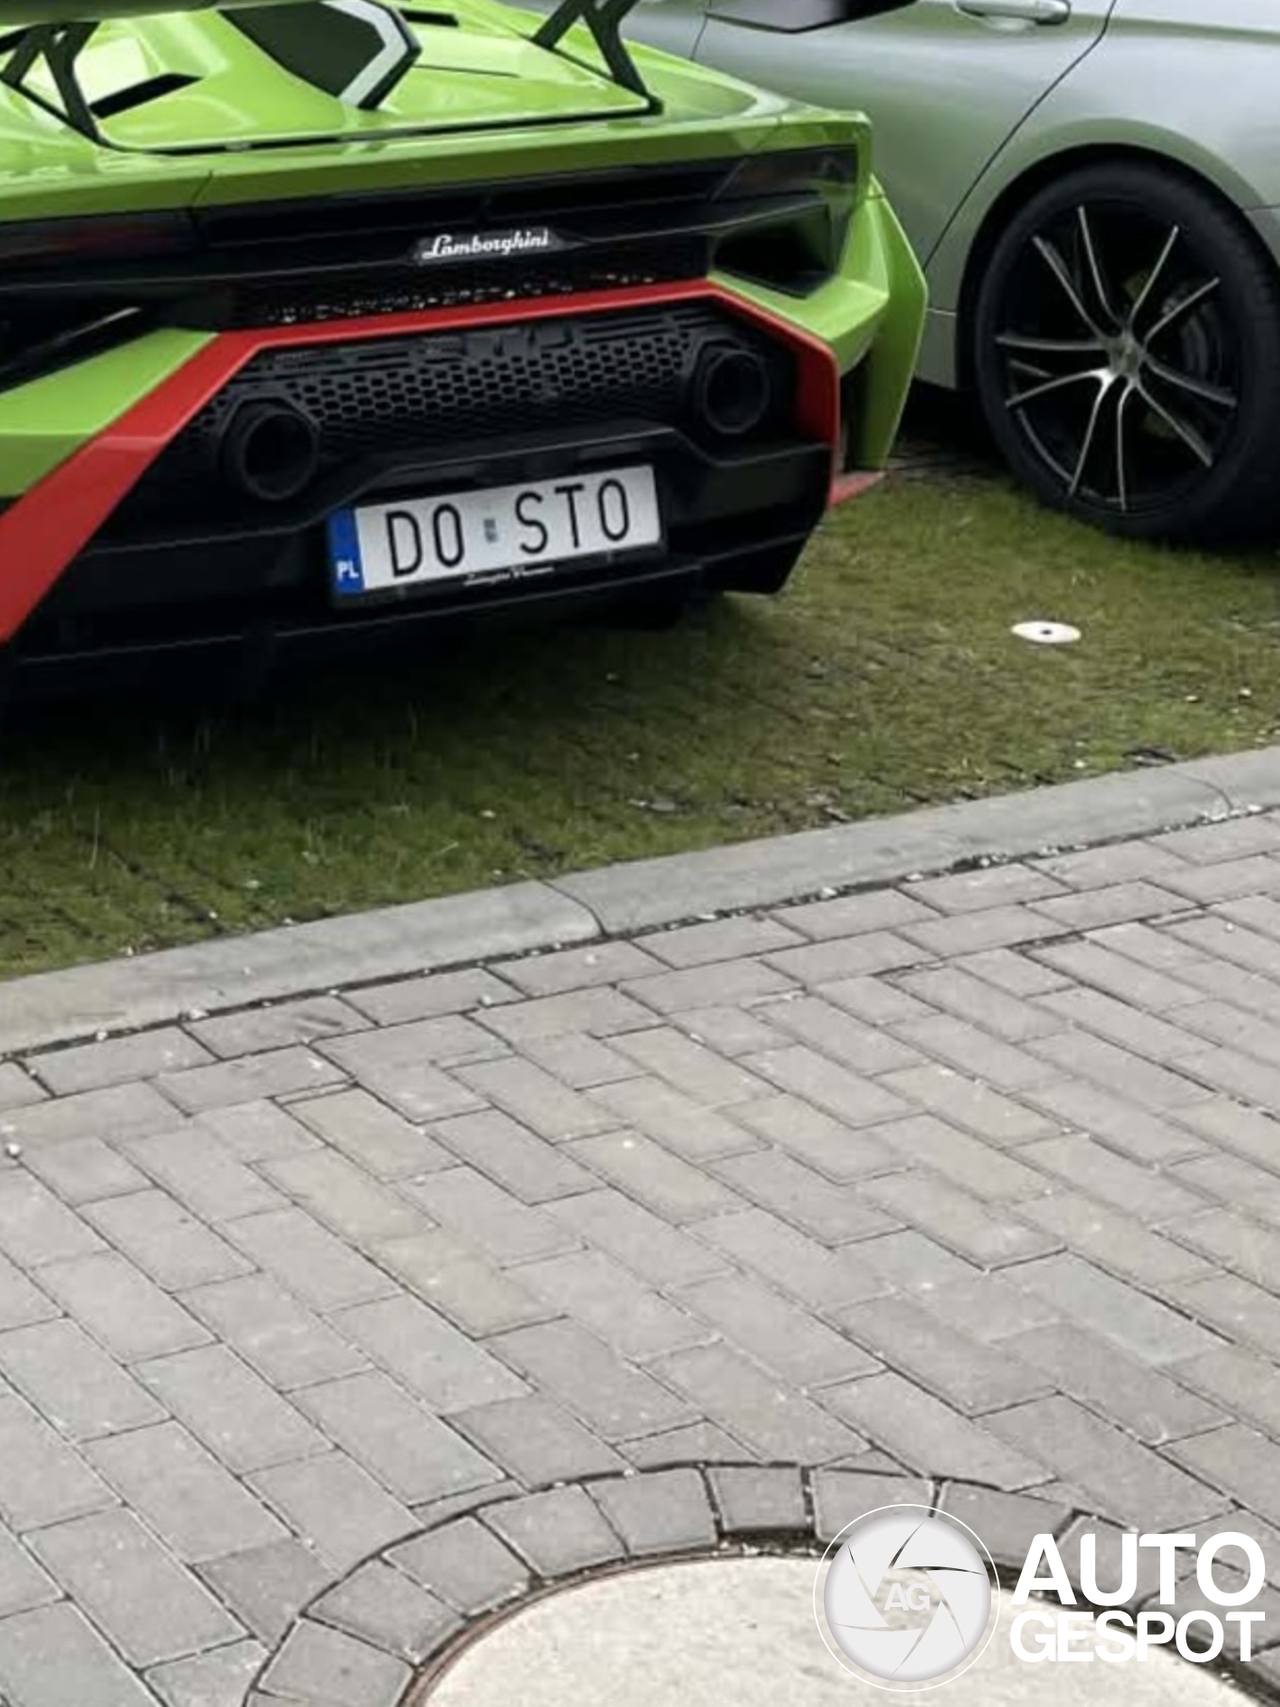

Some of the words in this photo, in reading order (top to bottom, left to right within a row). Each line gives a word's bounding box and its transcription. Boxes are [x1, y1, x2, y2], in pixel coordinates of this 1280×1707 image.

[421, 227, 549, 260] Lamborghini
[514, 478, 630, 555] STO
[336, 560, 360, 582] PL
